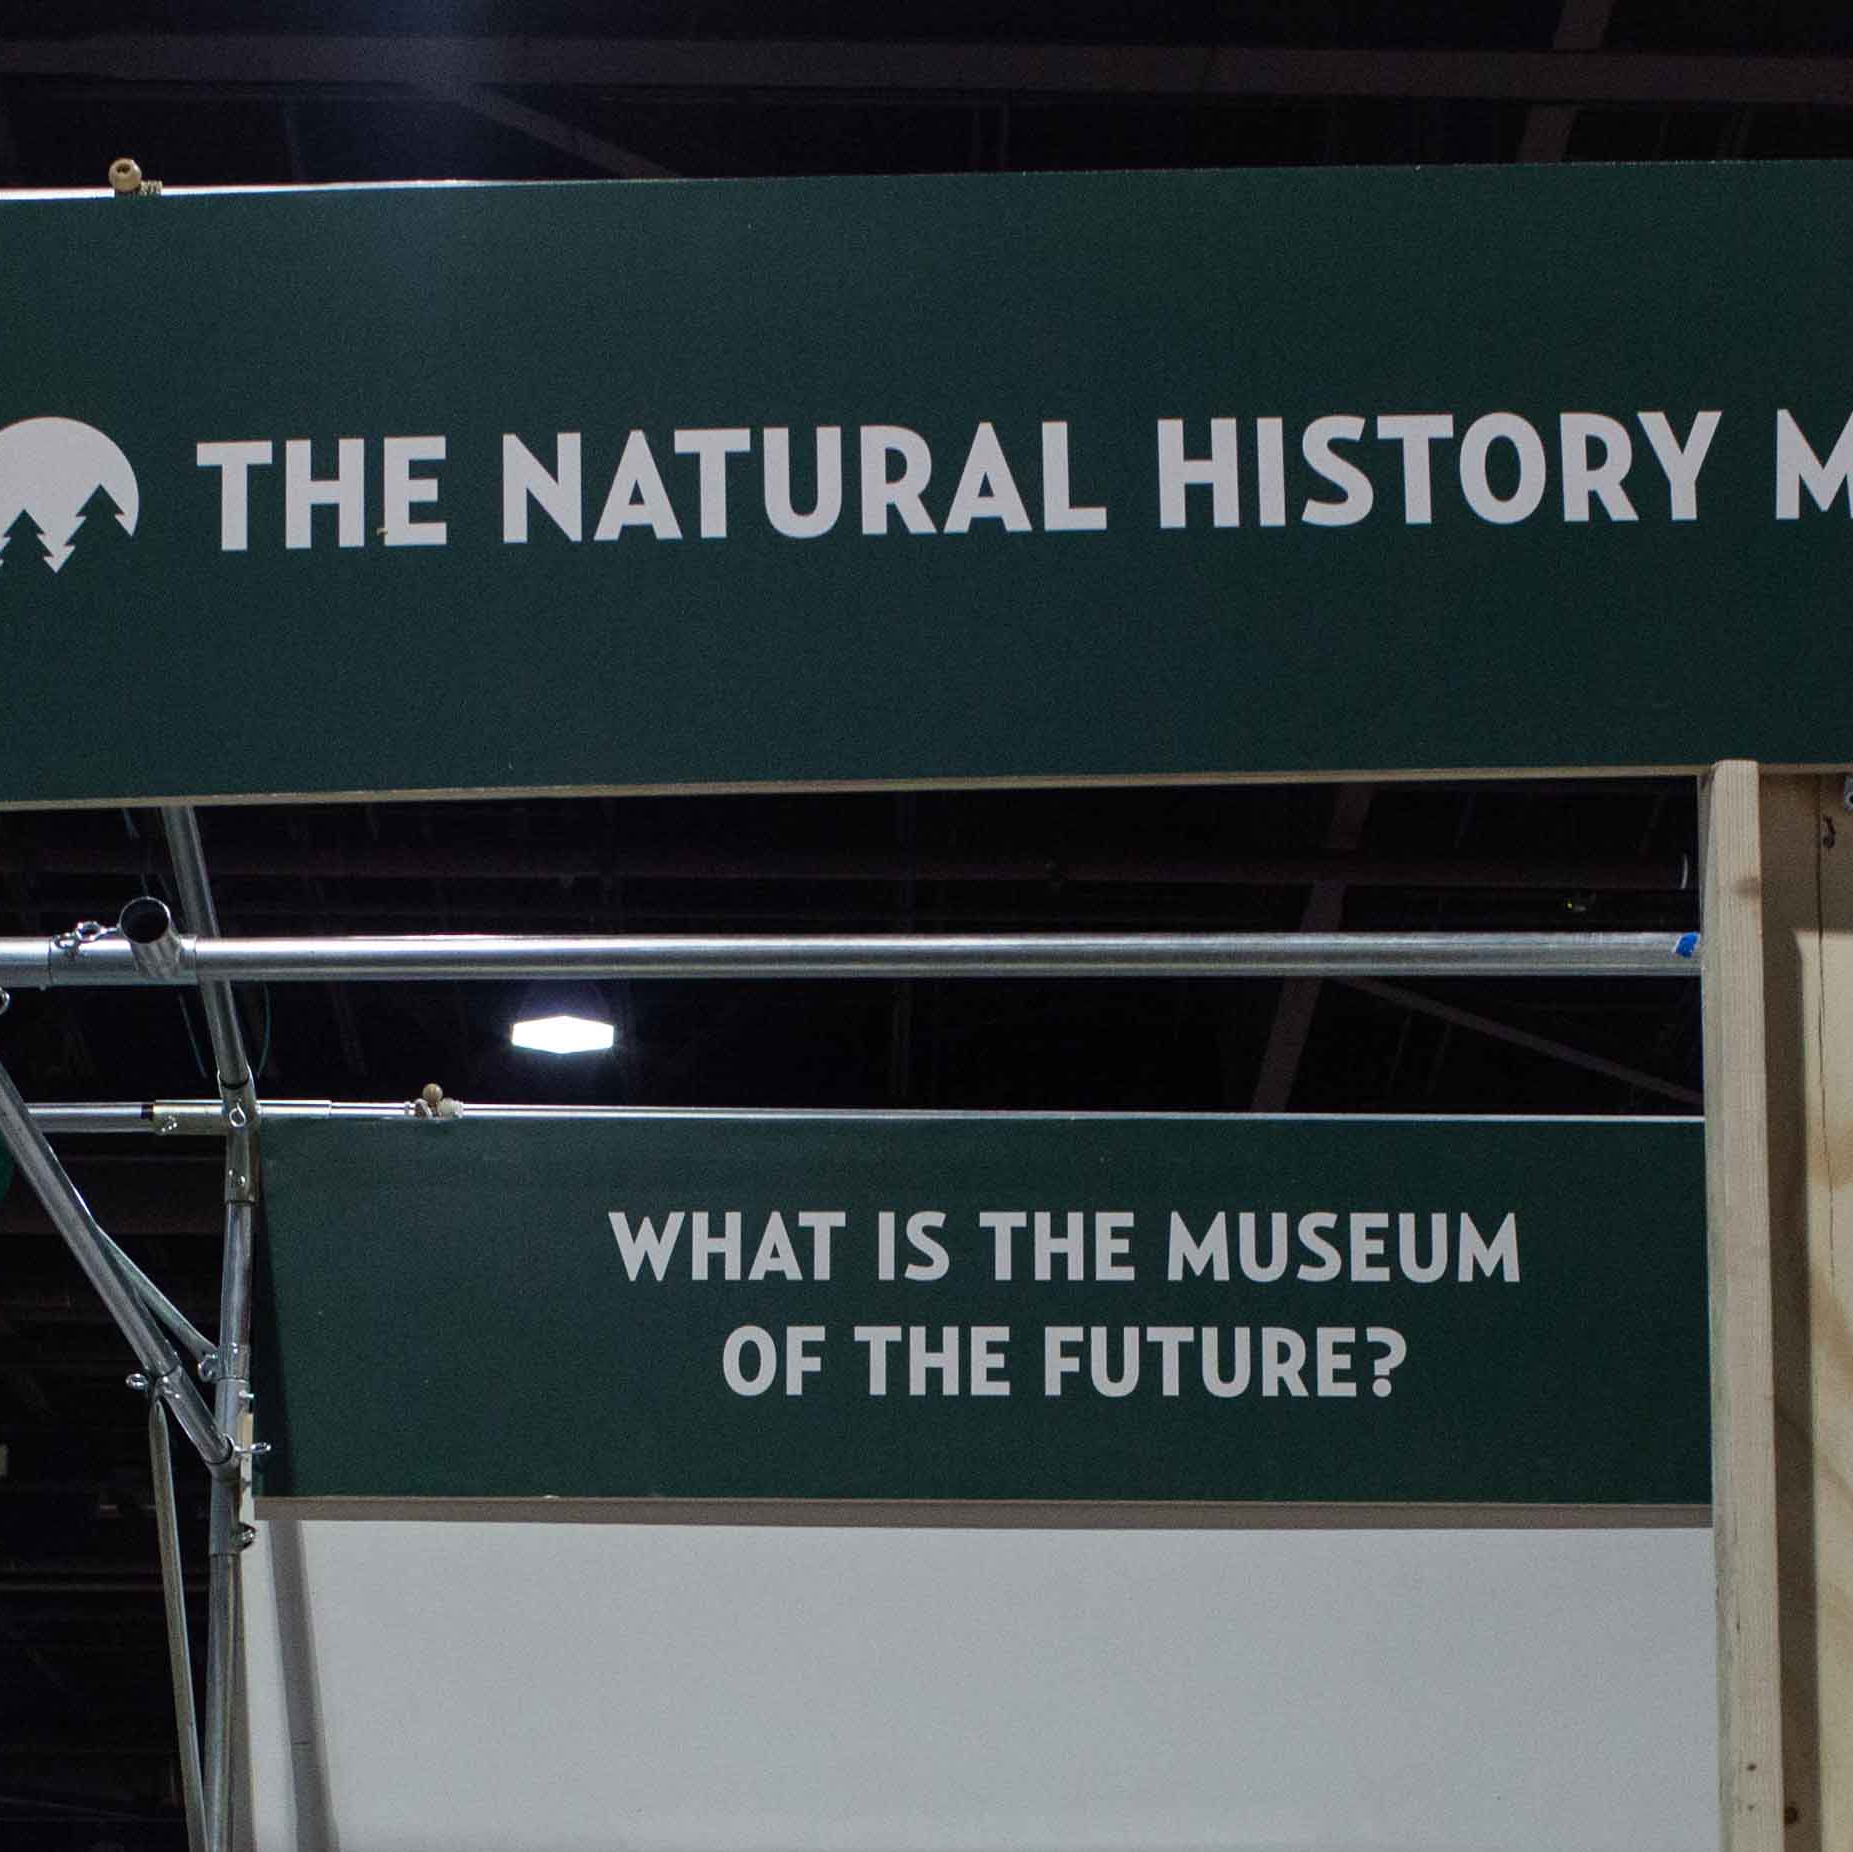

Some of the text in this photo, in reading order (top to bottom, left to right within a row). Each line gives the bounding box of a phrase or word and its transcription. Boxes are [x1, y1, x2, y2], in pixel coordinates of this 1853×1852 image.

[196, 435, 447, 551] THE
[502, 421, 1107, 544] NATURAL
[1157, 411, 1722, 529] HISTORY
[607, 1210, 1520, 1283] WHAT IS THE MUSEUM
[722, 1324, 1407, 1398] OF THE FUTURE?
